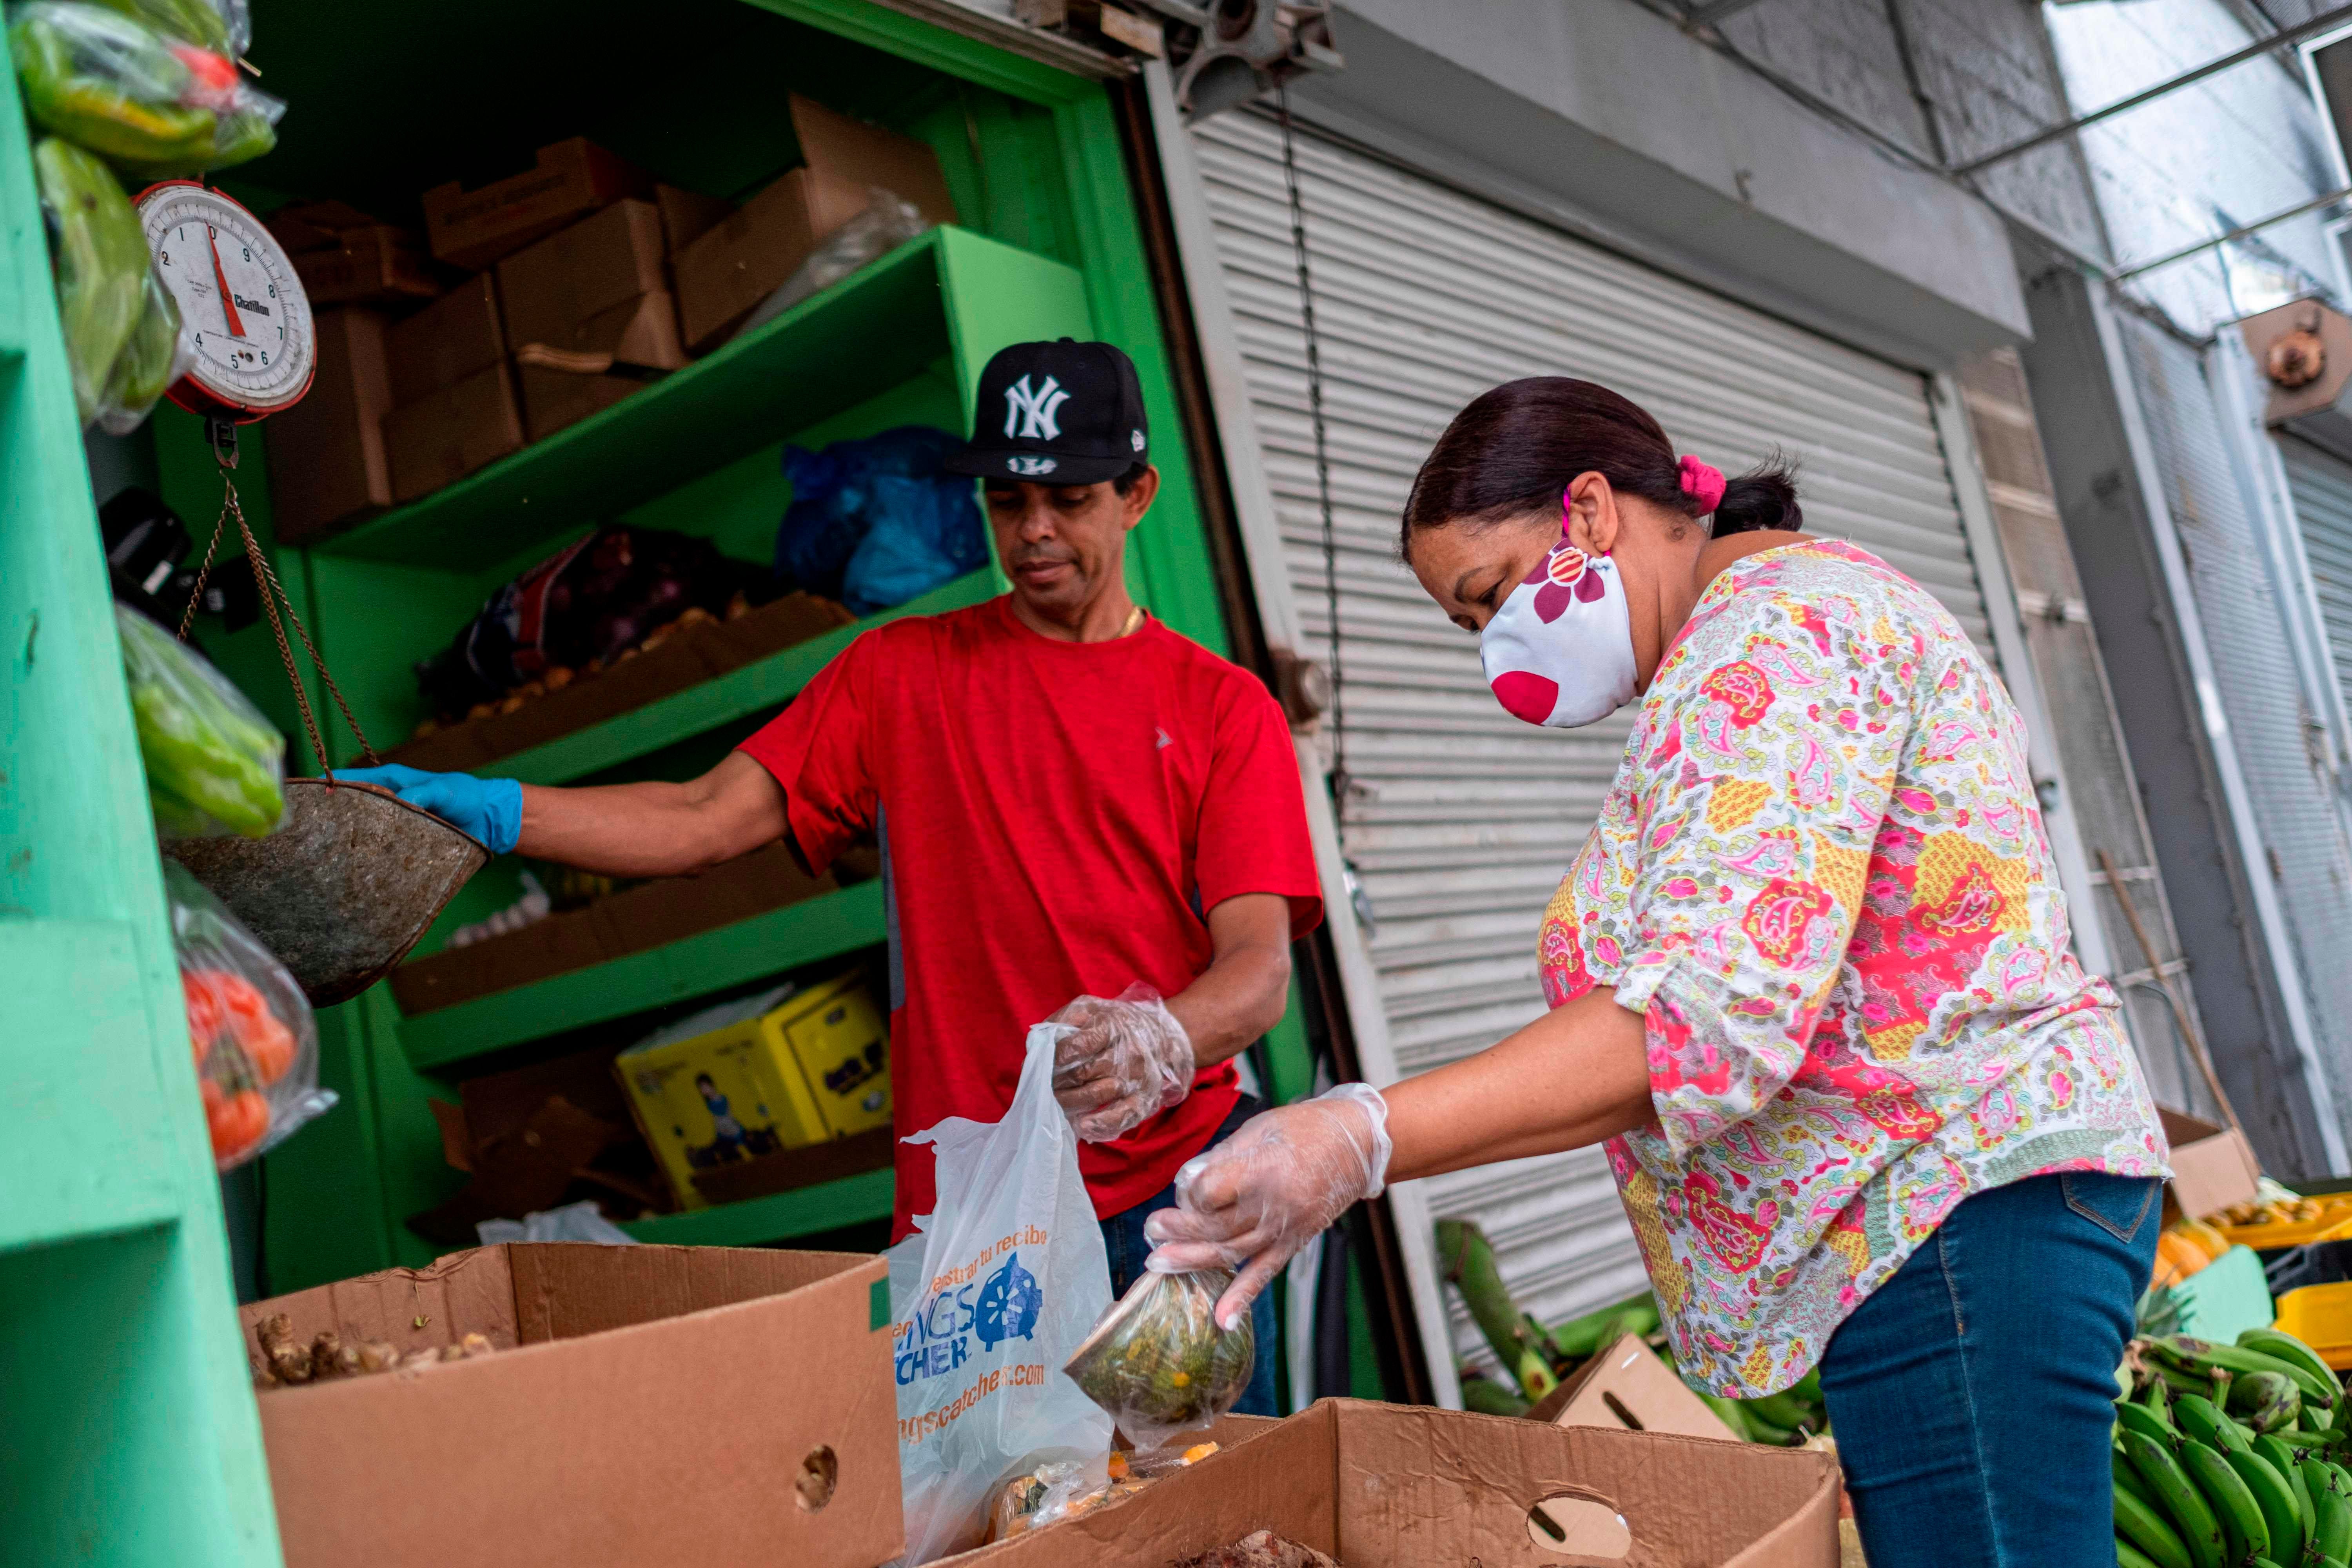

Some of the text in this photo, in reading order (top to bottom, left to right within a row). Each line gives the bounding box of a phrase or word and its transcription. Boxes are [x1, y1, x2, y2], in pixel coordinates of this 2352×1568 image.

[162, 251, 171, 266] 2
[243, 248, 250, 262] 9
[269, 285, 276, 298] 8
[234, 294, 270, 317] Chatillon
[195, 332, 203, 347] 4
[277, 326, 283, 340] 7
[231, 354, 238, 369] 5
[261, 351, 268, 365] 6
[1004, 373, 1071, 441] NY
[980, 1247, 992, 1266] tu
[995, 1224, 1047, 1256] recibo
[894, 1336, 967, 1385] CHER
